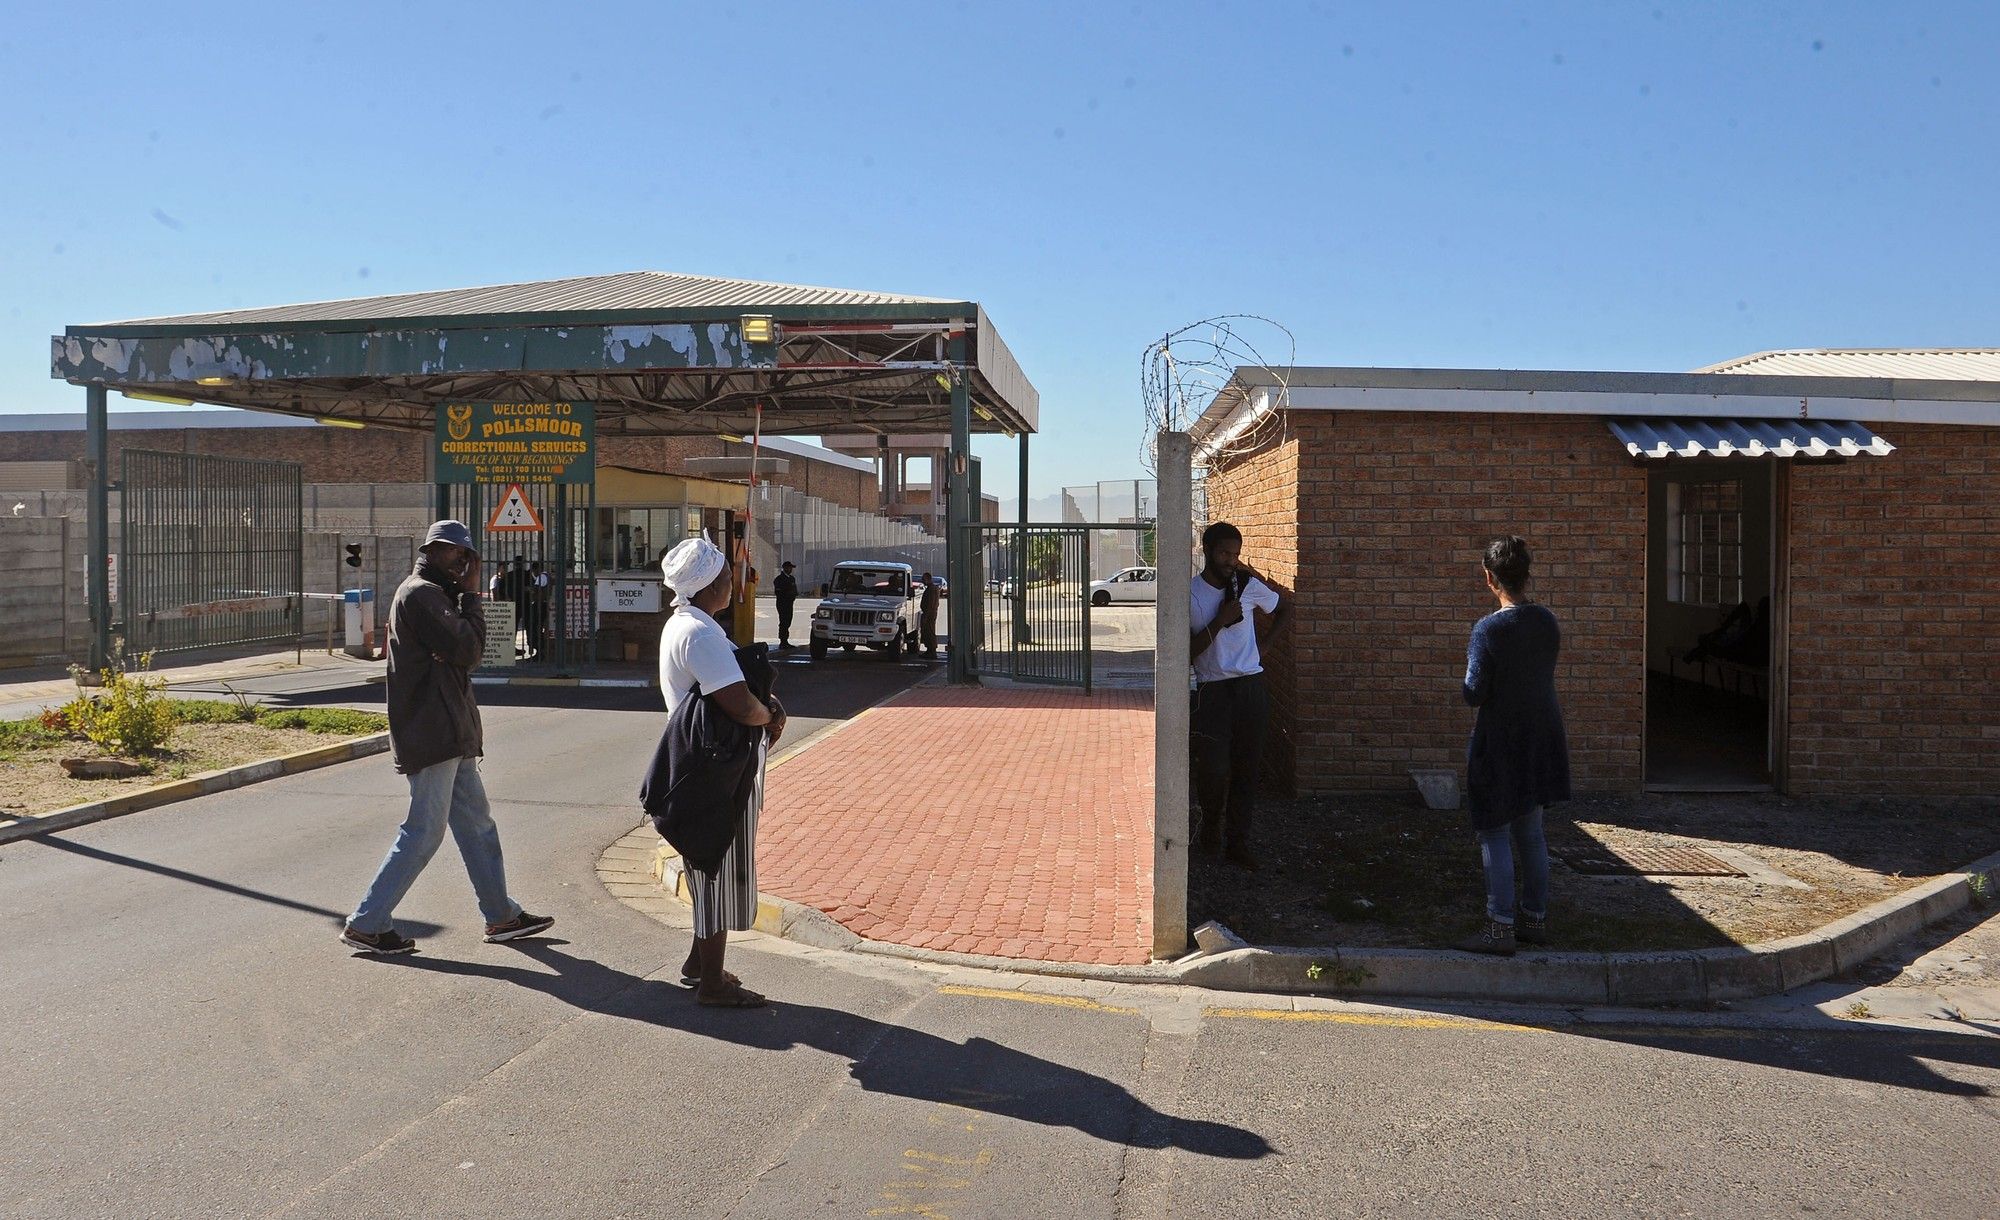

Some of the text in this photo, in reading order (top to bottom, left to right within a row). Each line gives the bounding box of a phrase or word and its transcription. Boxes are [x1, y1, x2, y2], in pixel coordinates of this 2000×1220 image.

[493, 403, 571, 415] WELCOME TO
[482, 417, 582, 437] POLLSMOOR
[442, 441, 587, 453] CORRECTIONAL SERVICES
[461, 455, 487, 464] PLACE
[488, 455, 502, 464] OF
[502, 455, 522, 464] NEW
[492, 465, 512, 474] (021)
[492, 475, 514, 483] (021)
[565, 588, 591, 599] TOP
[614, 589, 643, 598] TENDER
[618, 598, 635, 606] BOX
